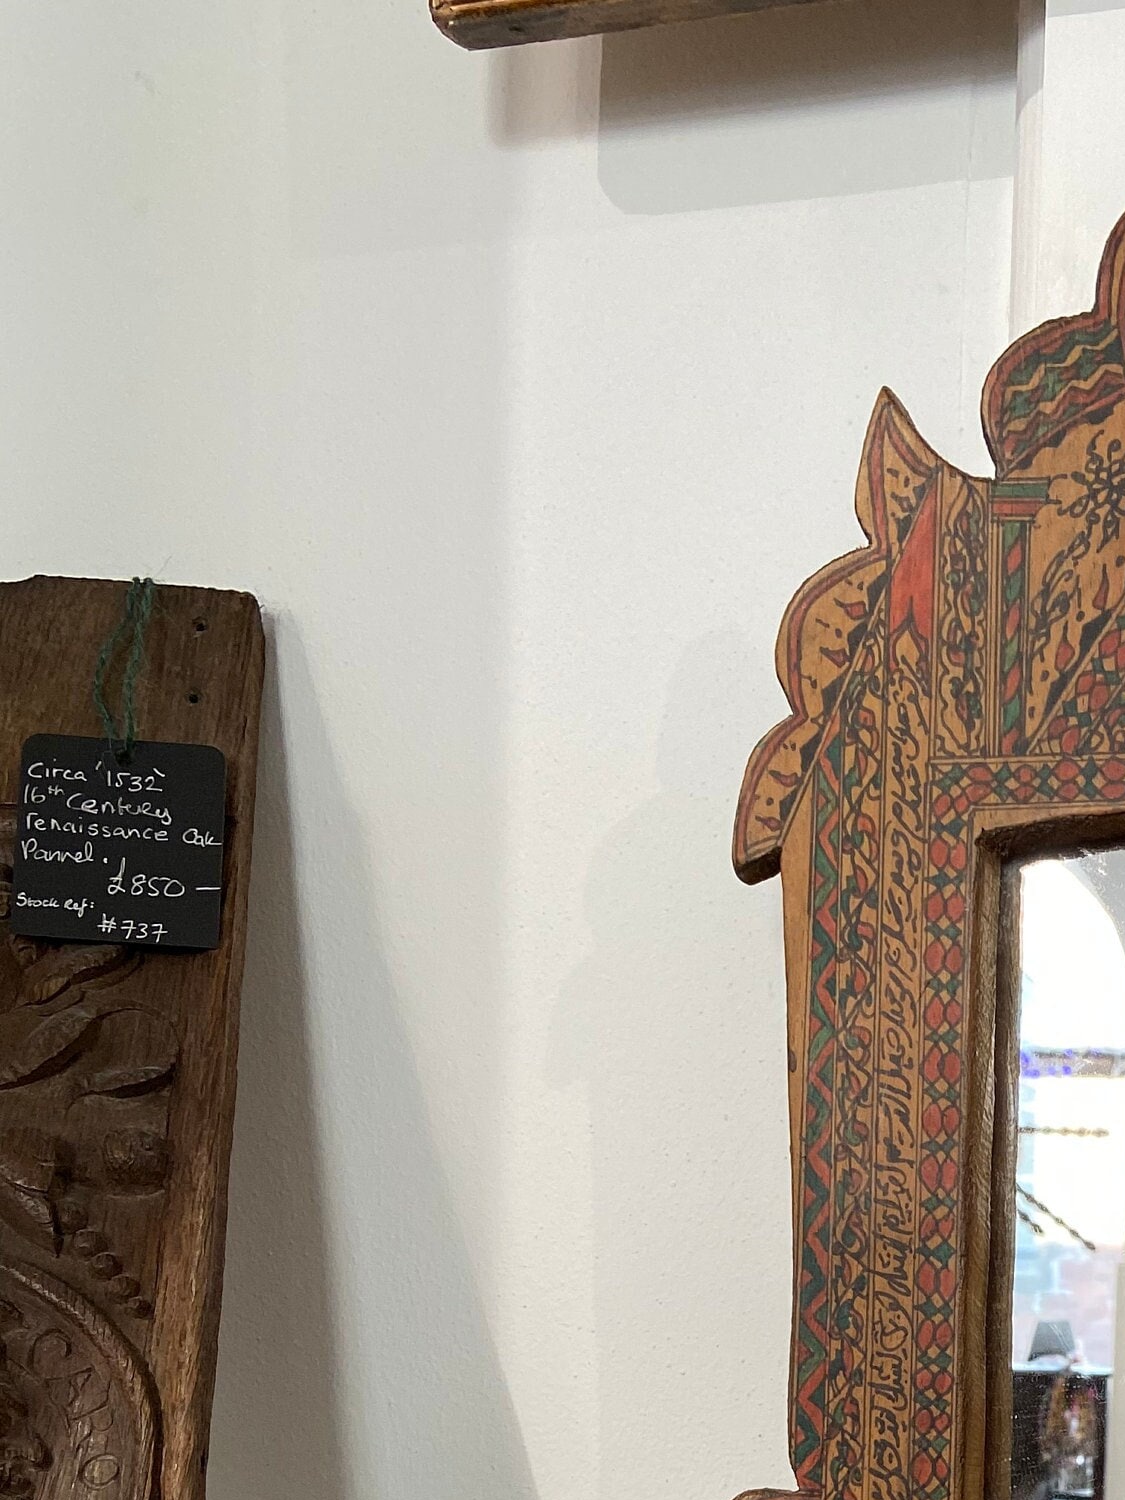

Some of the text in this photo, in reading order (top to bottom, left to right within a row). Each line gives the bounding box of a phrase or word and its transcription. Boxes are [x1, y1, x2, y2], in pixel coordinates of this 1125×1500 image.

[27, 758, 88, 782] Circa
[23, 783, 65, 804] 16th
[182, 828, 222, 848] Oak
[16, 891, 60, 908] Stock
[97, 913, 168, 943] #737
